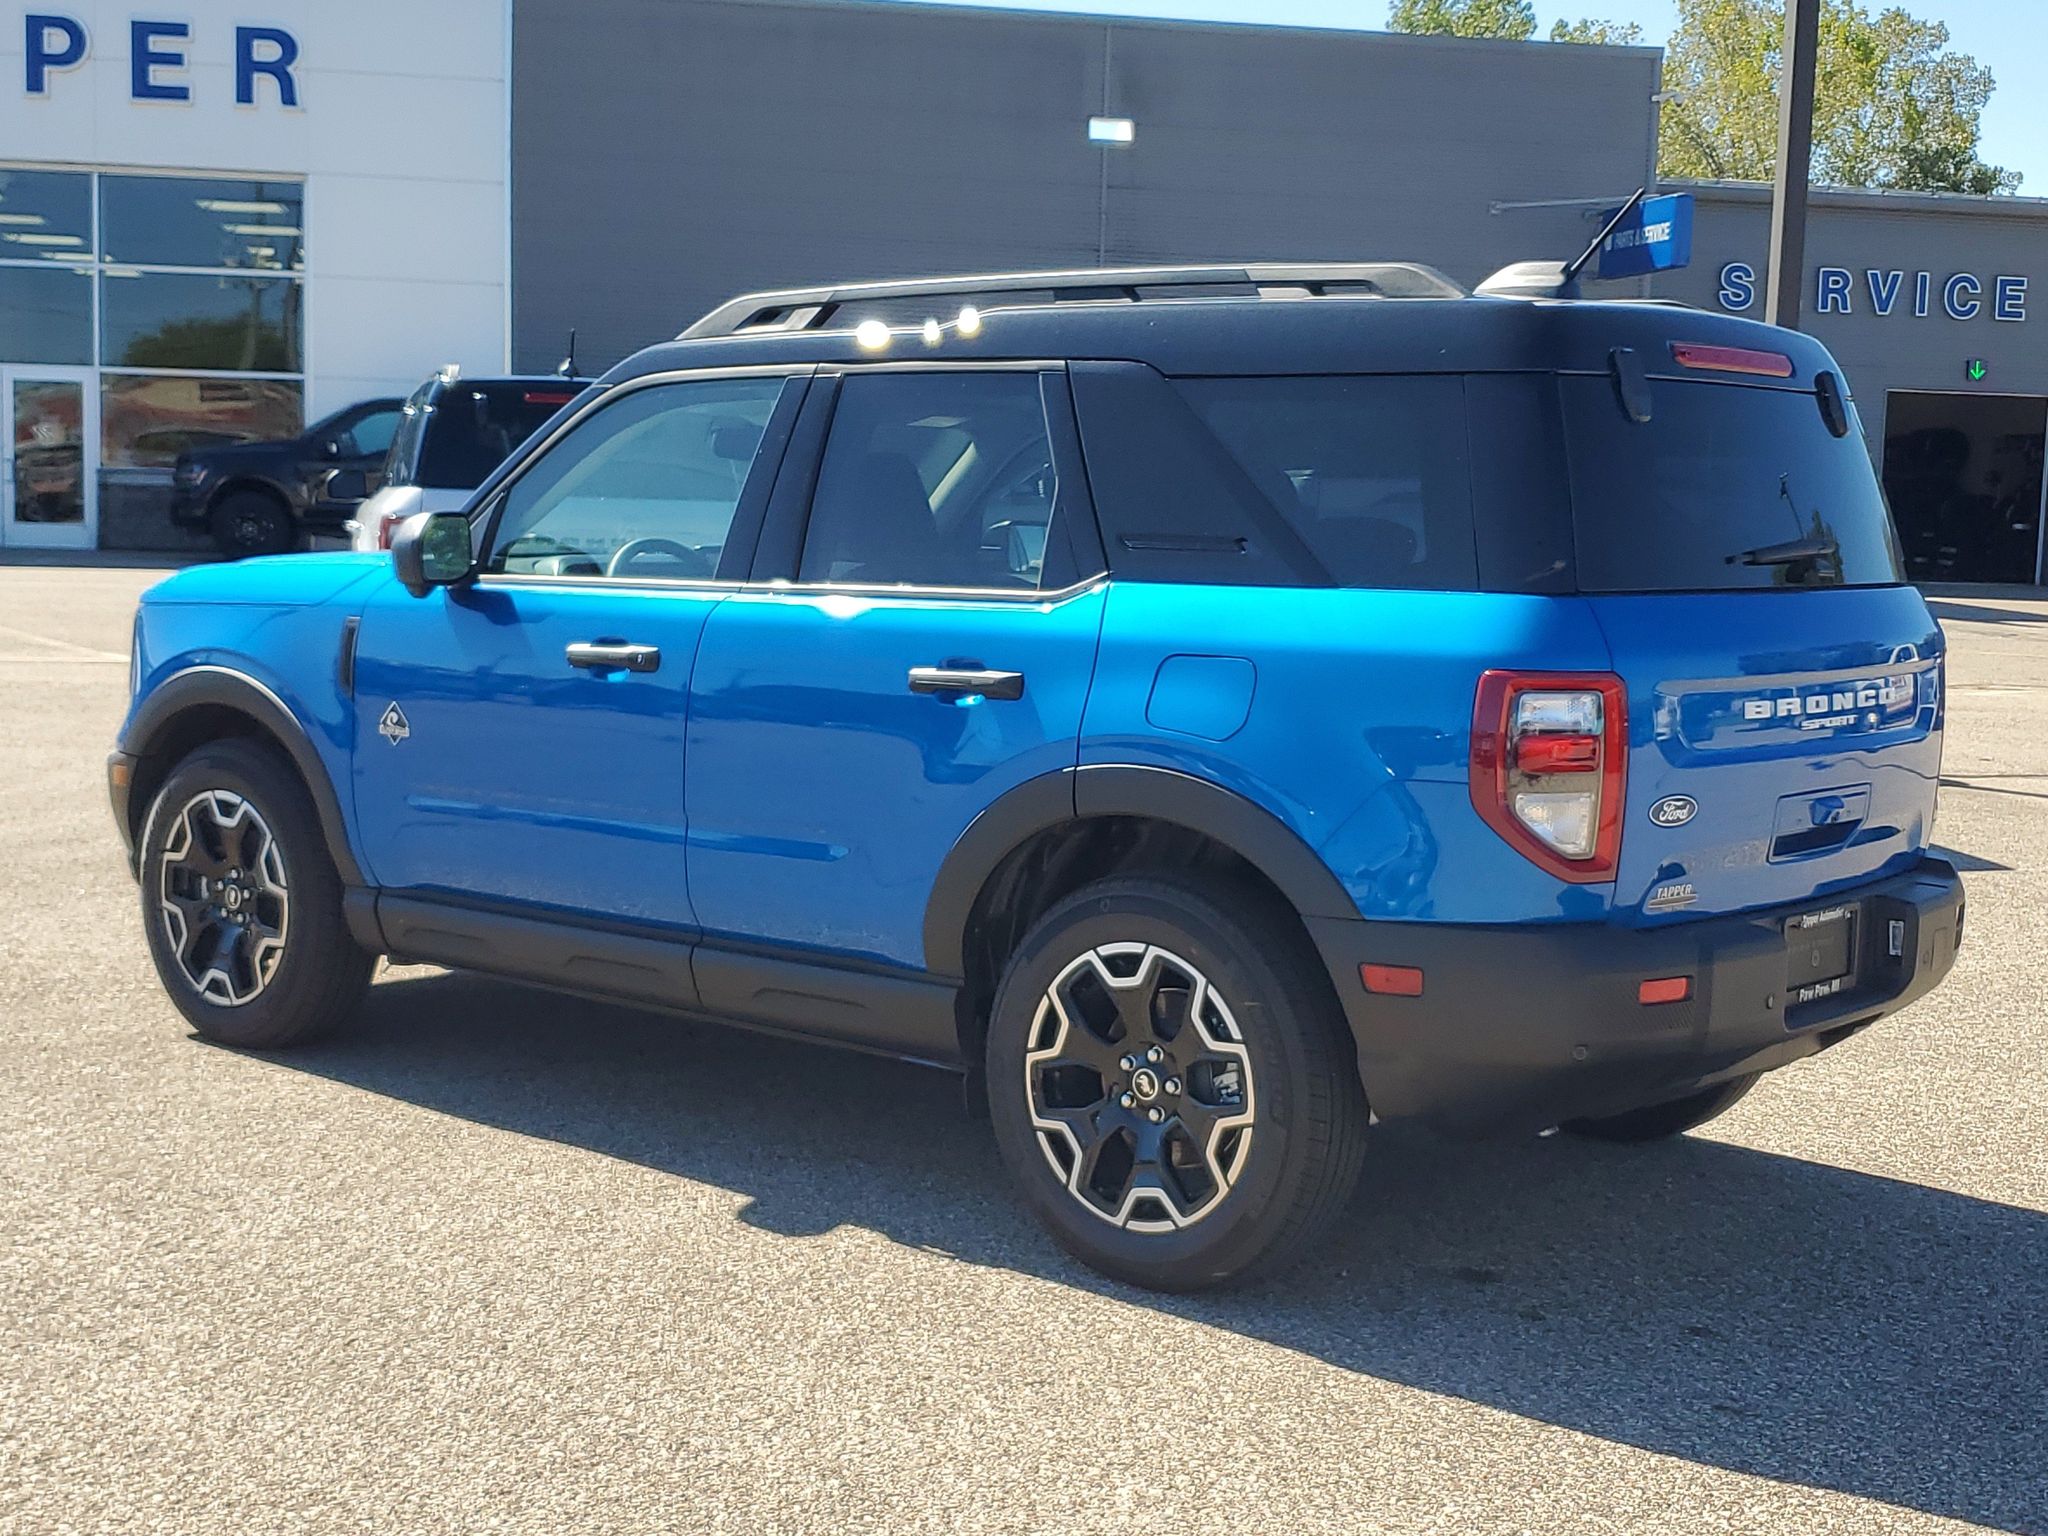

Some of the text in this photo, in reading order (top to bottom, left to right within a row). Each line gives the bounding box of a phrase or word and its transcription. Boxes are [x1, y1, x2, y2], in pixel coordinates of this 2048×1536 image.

[25, 15, 300, 107] PER
[1719, 262, 2028, 321] SRVICE
[1744, 687, 1897, 720] BRONCO
[1801, 714, 1859, 731] SPORT
[1656, 884, 1693, 900] TAPPER
